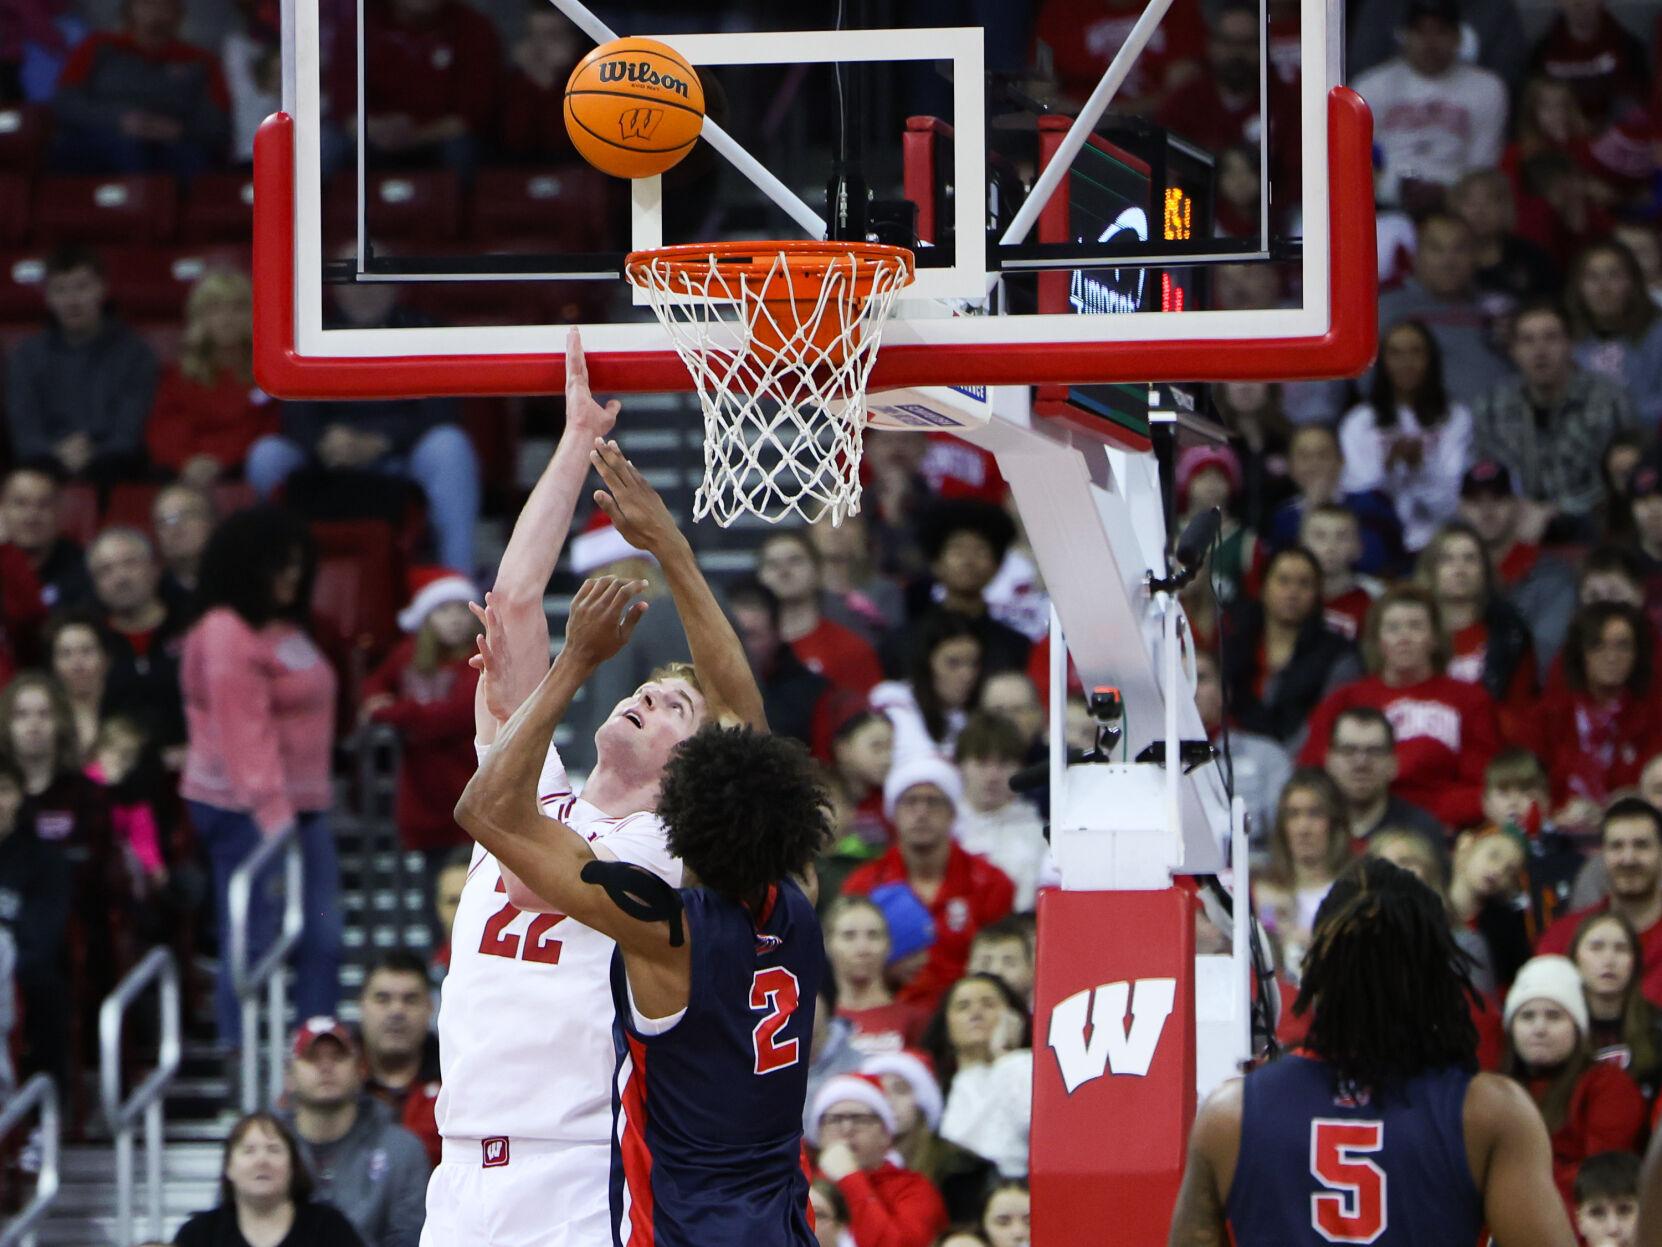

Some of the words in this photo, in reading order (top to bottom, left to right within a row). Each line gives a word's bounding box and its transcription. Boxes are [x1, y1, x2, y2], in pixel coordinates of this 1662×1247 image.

[600, 62, 688, 98] Wilson
[619, 108, 664, 140] W
[749, 966, 800, 1075] 2
[1047, 978, 1176, 1096] W
[487, 1141, 503, 1161] W
[1310, 1118, 1388, 1245] 5
